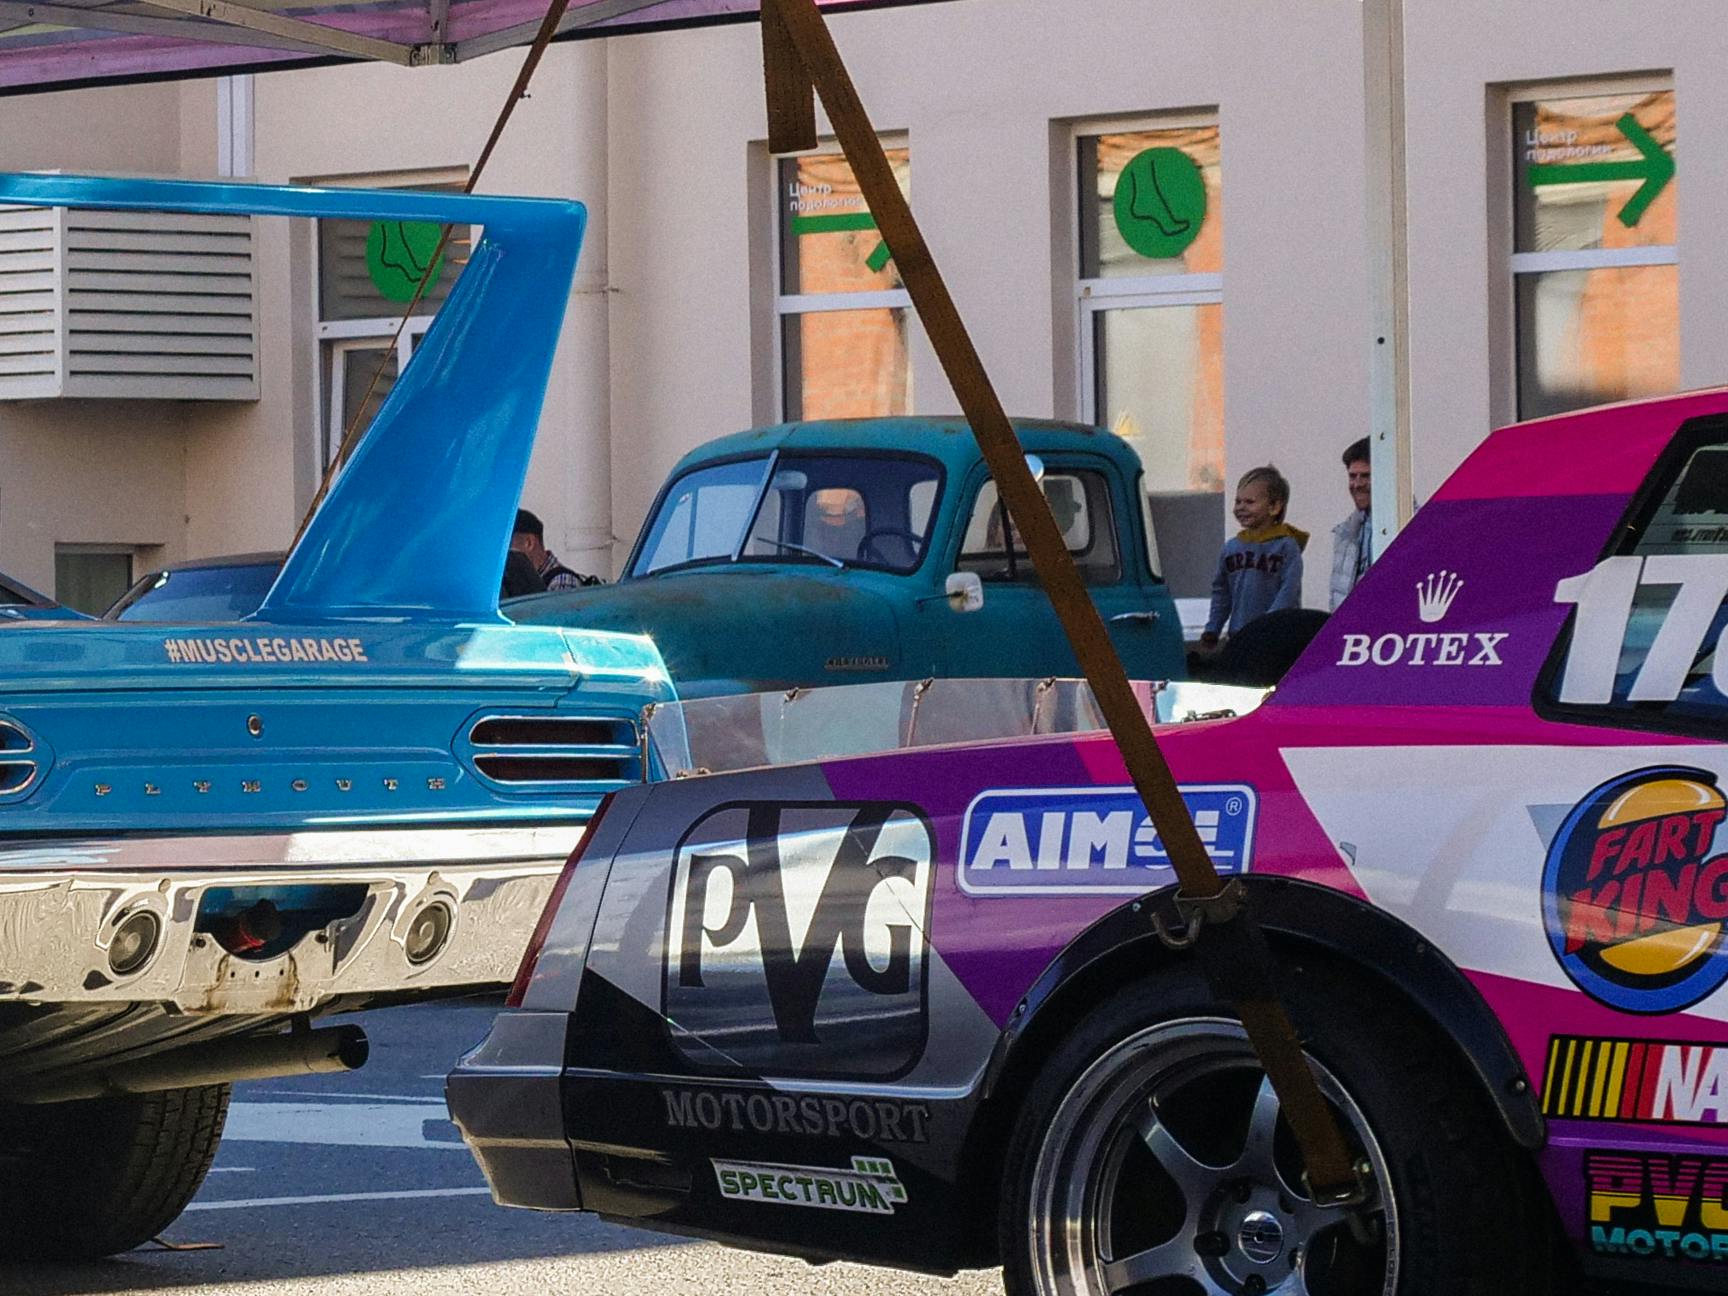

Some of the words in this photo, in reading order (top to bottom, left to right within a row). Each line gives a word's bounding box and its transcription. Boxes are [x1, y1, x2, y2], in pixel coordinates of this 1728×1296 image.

[164, 636, 368, 664] #MUSCLEGARAGE
[1336, 632, 1509, 666] BOTEX
[1554, 554, 1728, 704] 17
[1588, 808, 1725, 881] FART
[1564, 857, 1728, 955] KING
[662, 1088, 931, 1145] MOTORSPORT
[719, 1169, 890, 1211] SPECTRUM
